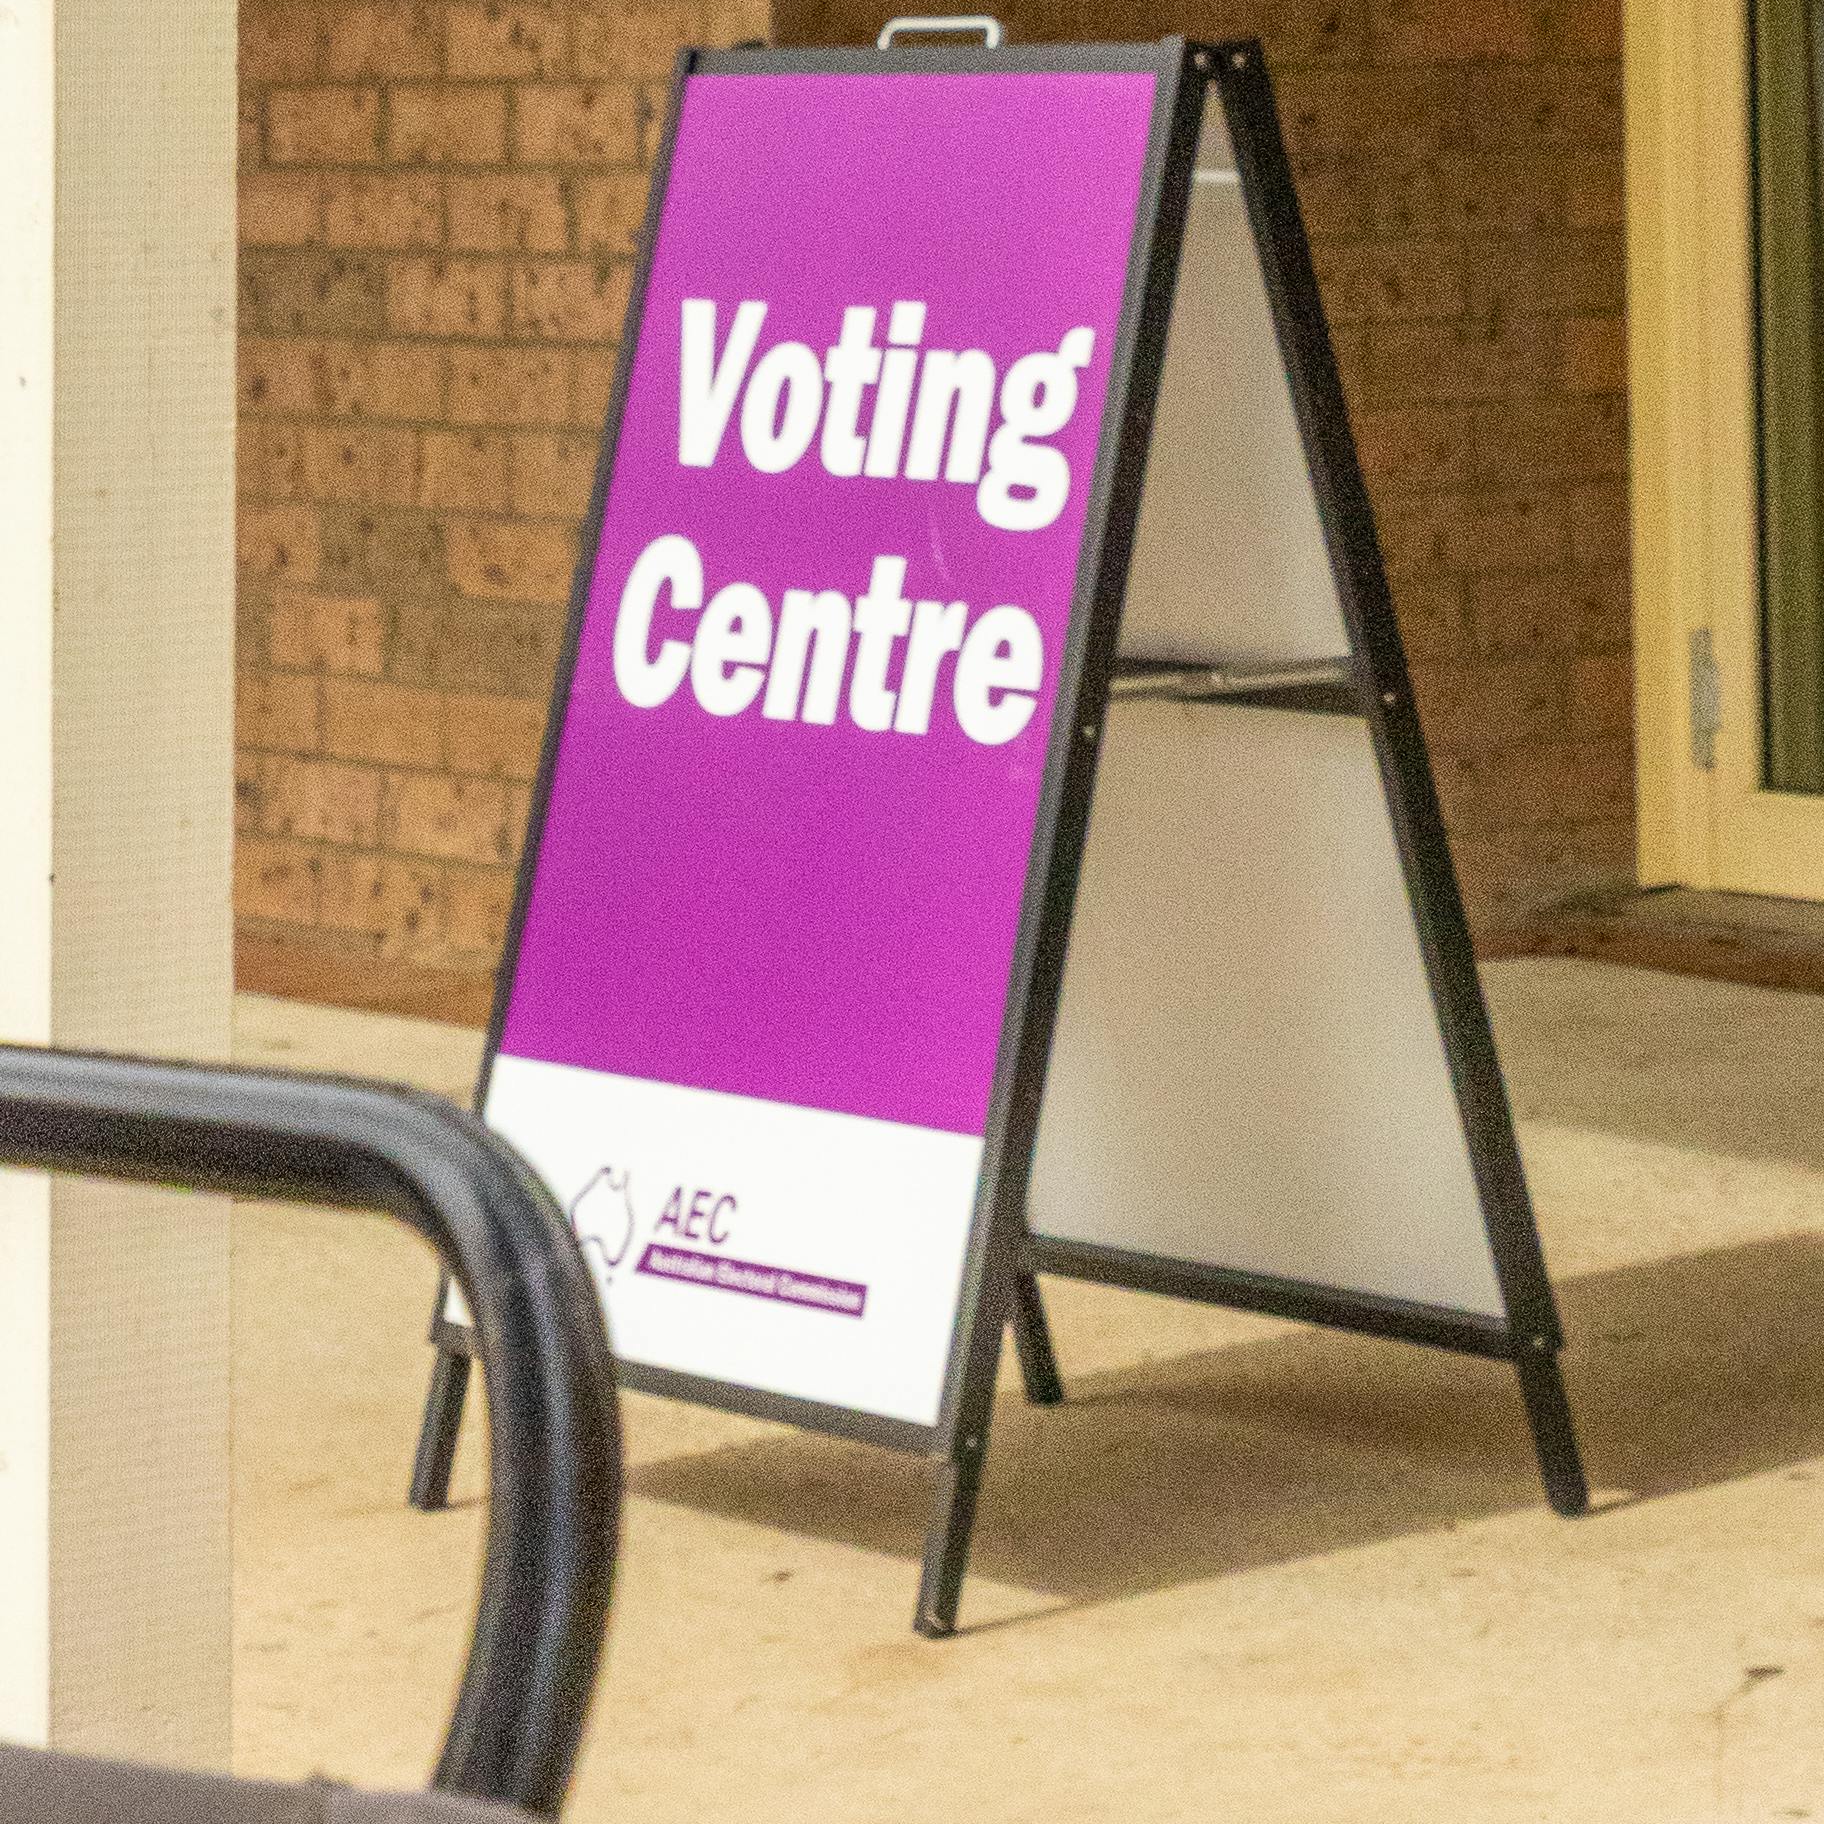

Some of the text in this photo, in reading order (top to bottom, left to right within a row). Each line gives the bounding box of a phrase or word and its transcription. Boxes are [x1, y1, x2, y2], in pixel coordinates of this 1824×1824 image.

[678, 296, 1096, 532] Voting
[612, 533, 1044, 746] Centre
[653, 1184, 738, 1246] AEC
